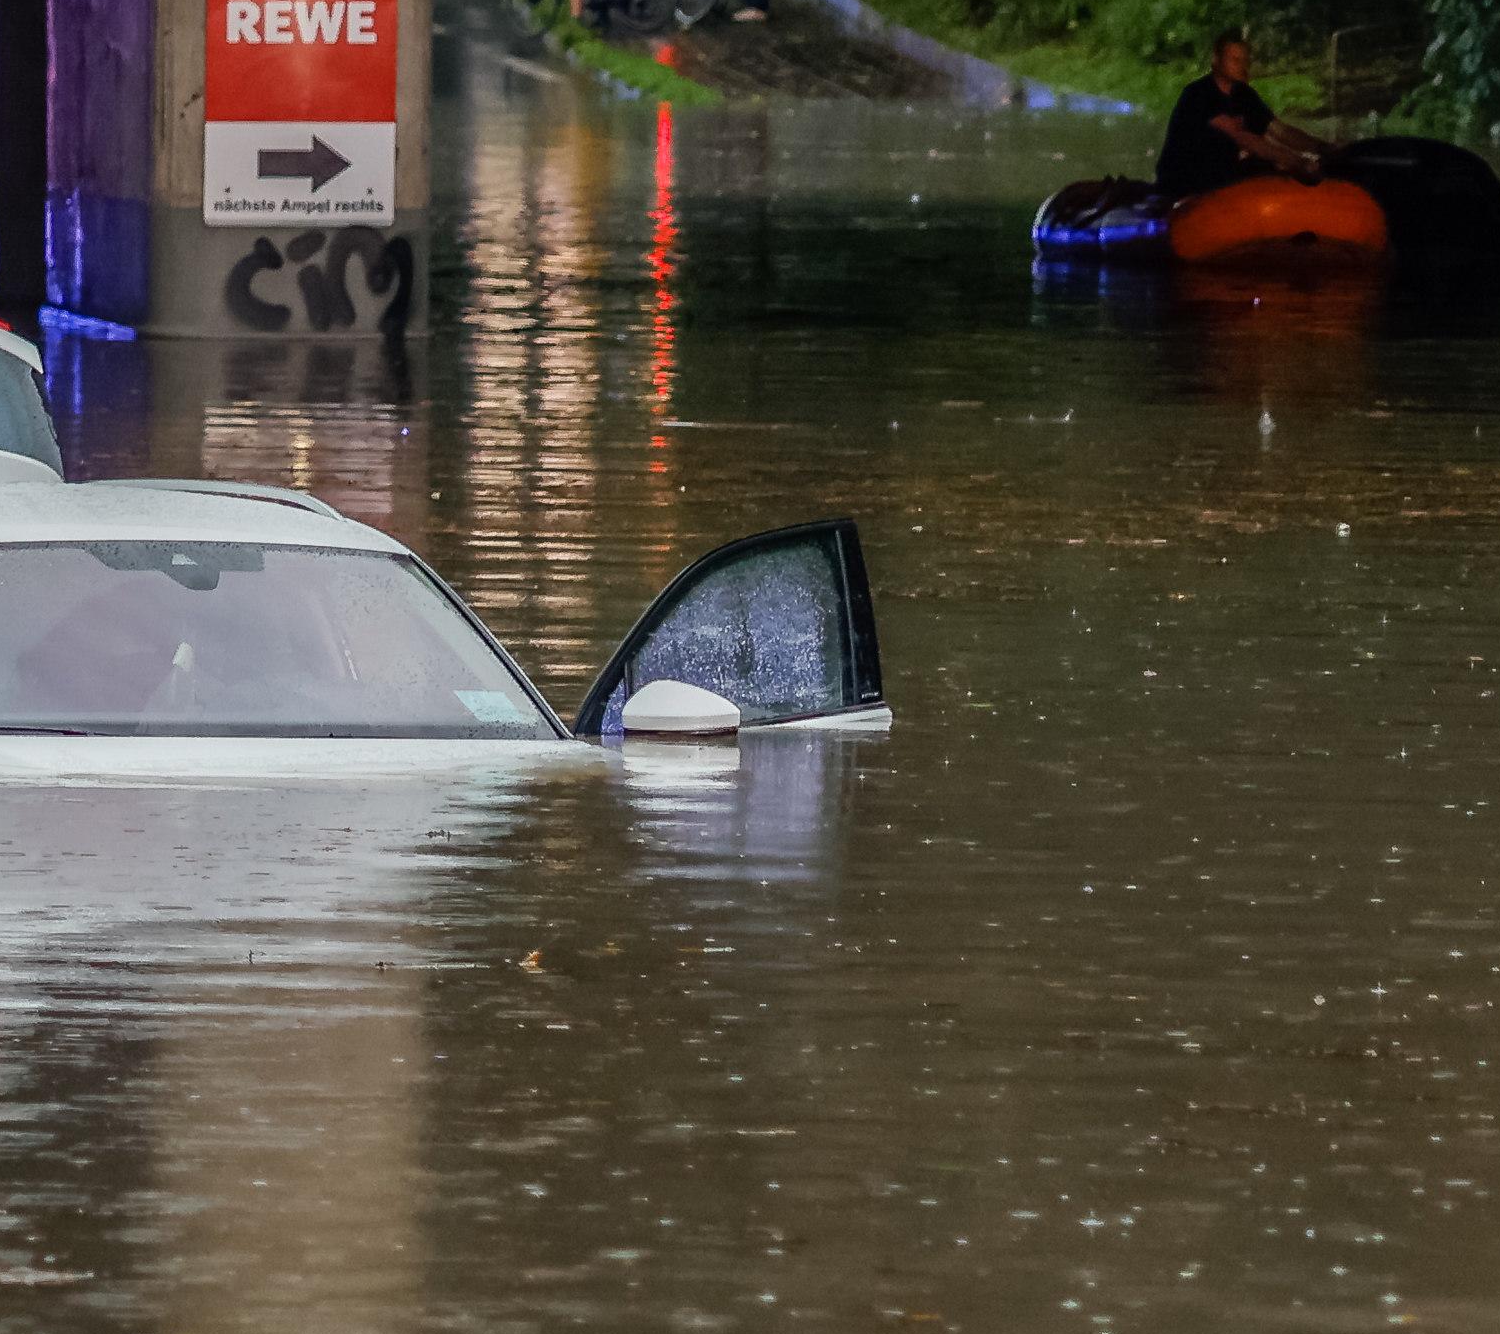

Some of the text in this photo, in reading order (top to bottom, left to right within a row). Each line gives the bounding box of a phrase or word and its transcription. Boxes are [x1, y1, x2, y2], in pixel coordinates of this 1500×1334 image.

[225, 0, 378, 45] REWE
[280, 198, 331, 214] Ampel
[334, 199, 385, 212] rechts
